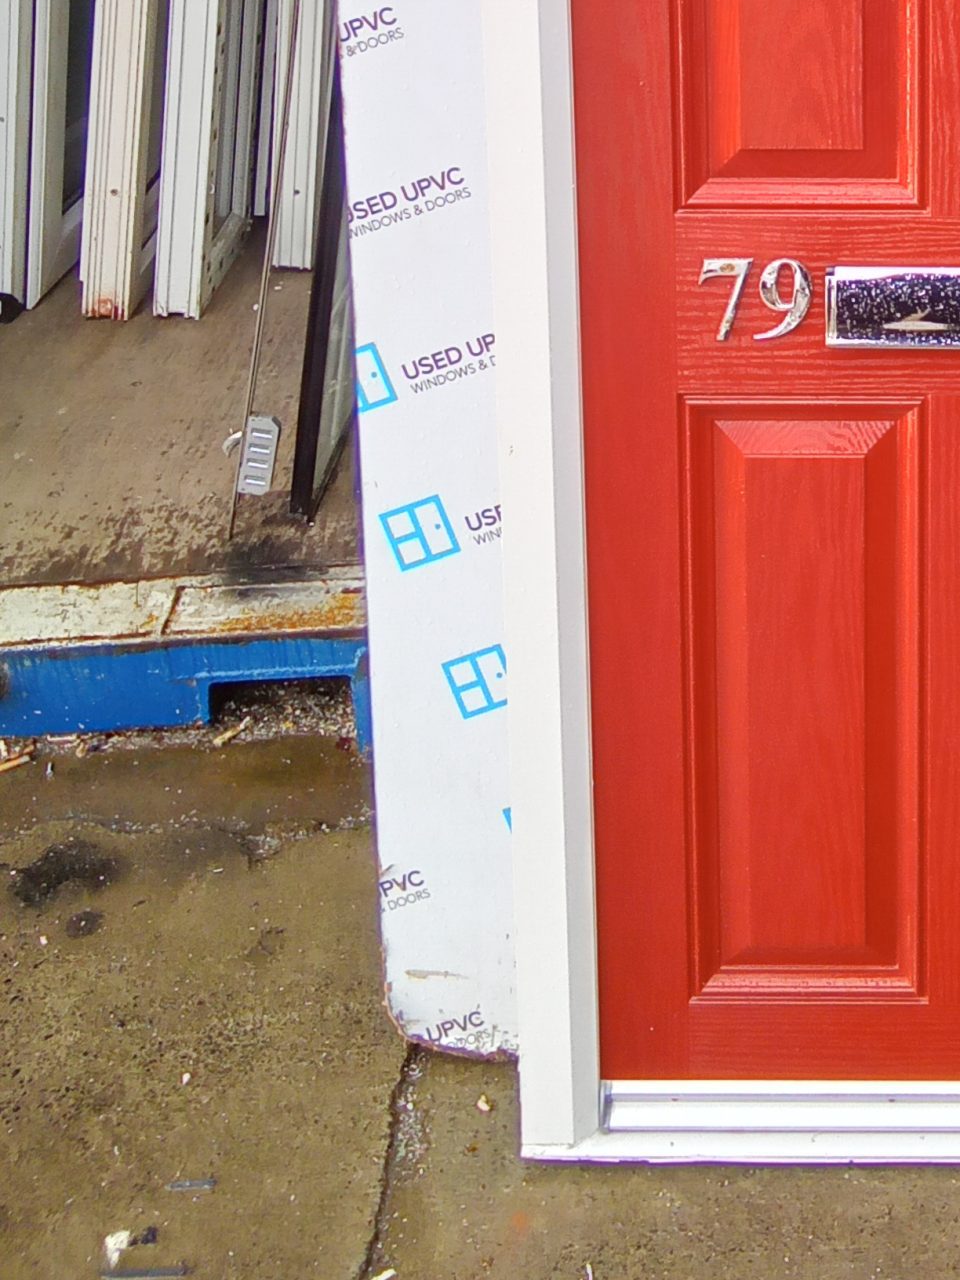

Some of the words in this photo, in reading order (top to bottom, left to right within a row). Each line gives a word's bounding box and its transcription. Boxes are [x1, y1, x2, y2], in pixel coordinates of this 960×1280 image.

[346, 45, 357, 57] &
[357, 27, 405, 53] DOORS
[400, 167, 465, 201] UPVC
[413, 204, 423, 216] &
[425, 187, 471, 212] DOORS
[698, 258, 813, 341] 79
[401, 346, 462, 380] USED
[465, 333, 496, 357] UP
[410, 363, 477, 394] WINDOWS
[478, 359, 488, 371] &
[379, 870, 424, 898] PVC
[387, 888, 431, 911] DOORS
[426, 1011, 485, 1042] UPVC
